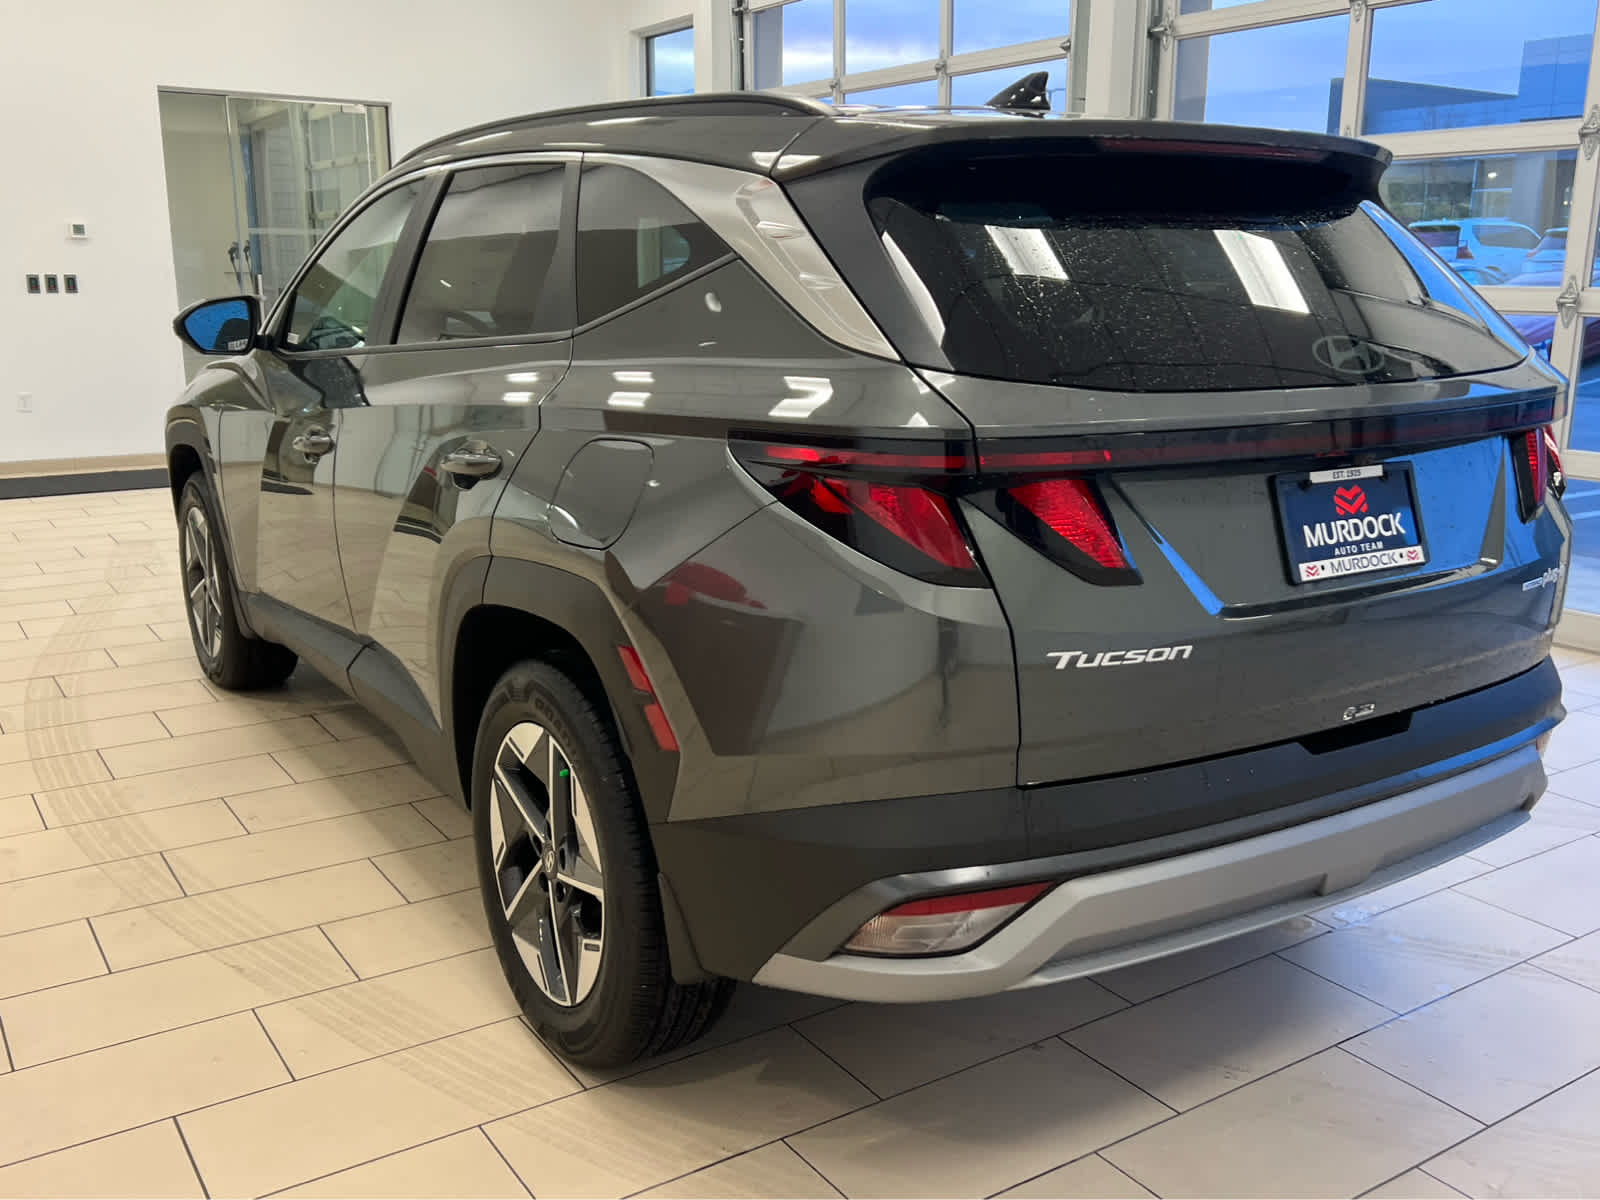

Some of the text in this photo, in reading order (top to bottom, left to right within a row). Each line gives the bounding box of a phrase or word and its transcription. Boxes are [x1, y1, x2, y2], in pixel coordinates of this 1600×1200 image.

[1303, 513, 1405, 548] MURDOCK
[1335, 541, 1384, 556] AUTO TEAM
[1330, 553, 1397, 574] MURDOCK
